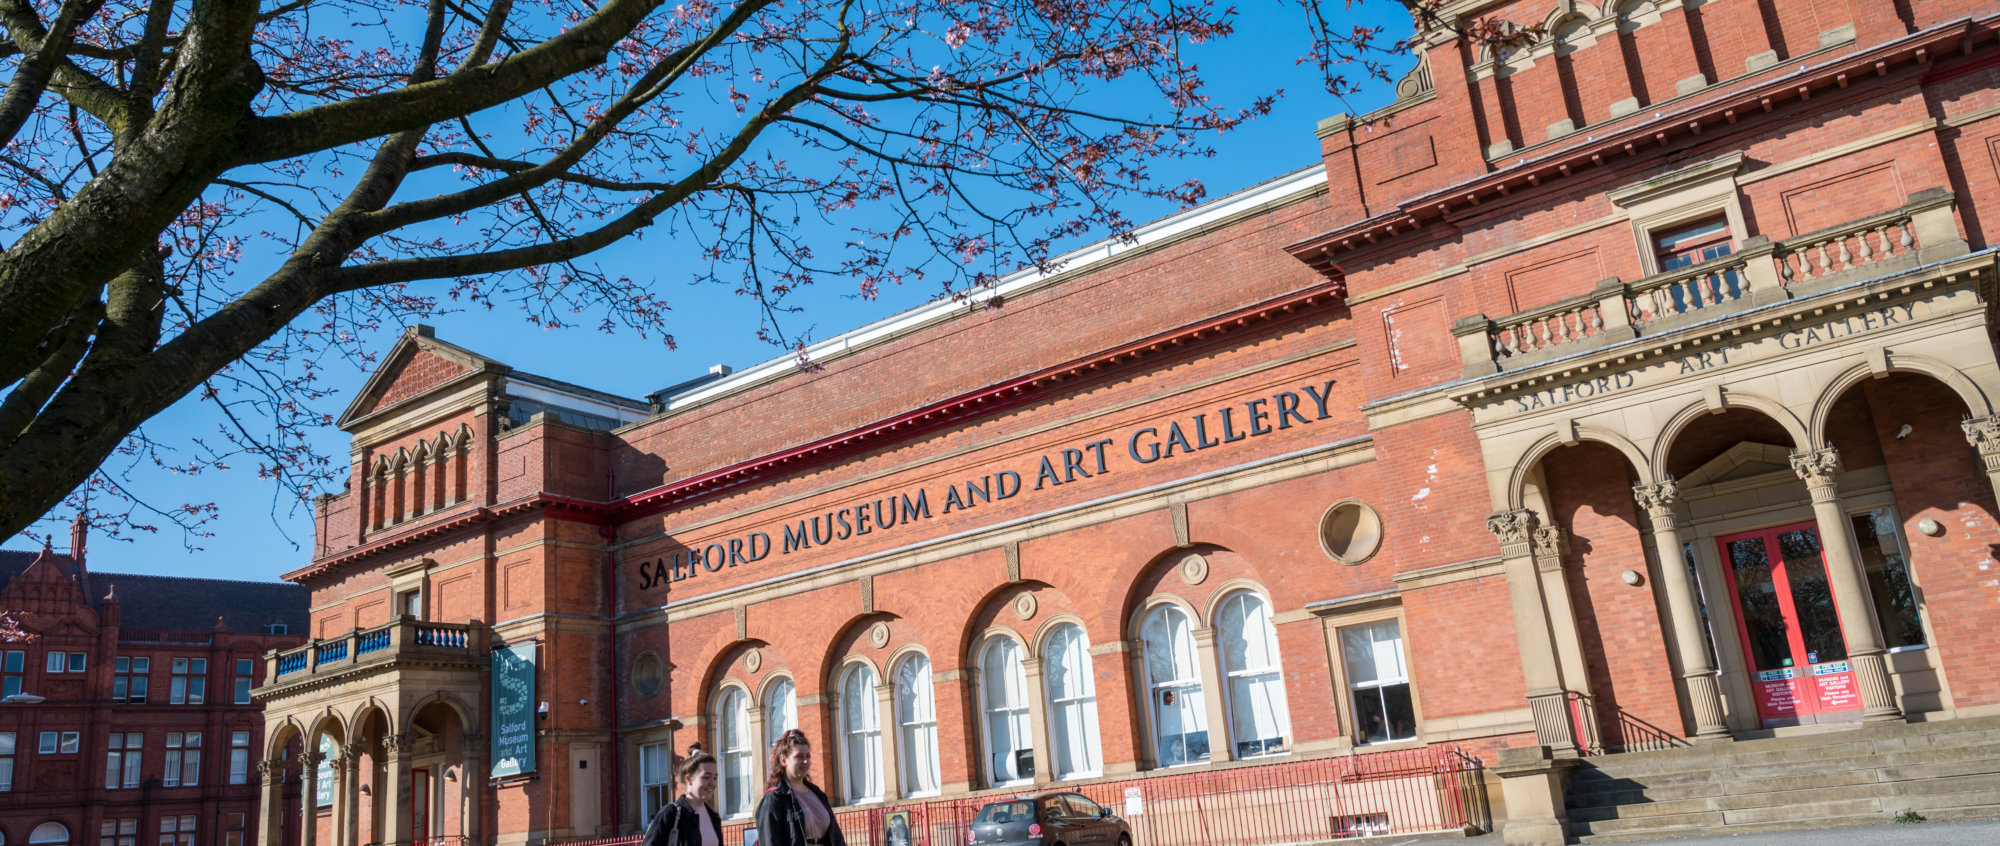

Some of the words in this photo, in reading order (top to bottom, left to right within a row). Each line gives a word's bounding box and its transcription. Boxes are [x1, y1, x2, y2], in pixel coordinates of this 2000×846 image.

[1516, 371, 1634, 413] SALFORD
[1680, 346, 1730, 375] ART
[1779, 301, 1917, 350] GALLERY
[639, 531, 770, 590] SALFORD
[782, 488, 931, 554] MUSEUM
[942, 469, 1021, 514] AND
[1034, 438, 1113, 490] ART
[1128, 380, 1336, 464] GALLERY
[501, 720, 526, 735] Salford
[499, 733, 529, 746] Museum
[515, 745, 528, 755] Art
[501, 756, 527, 769] Gallery
[317, 770, 333, 780] seum
